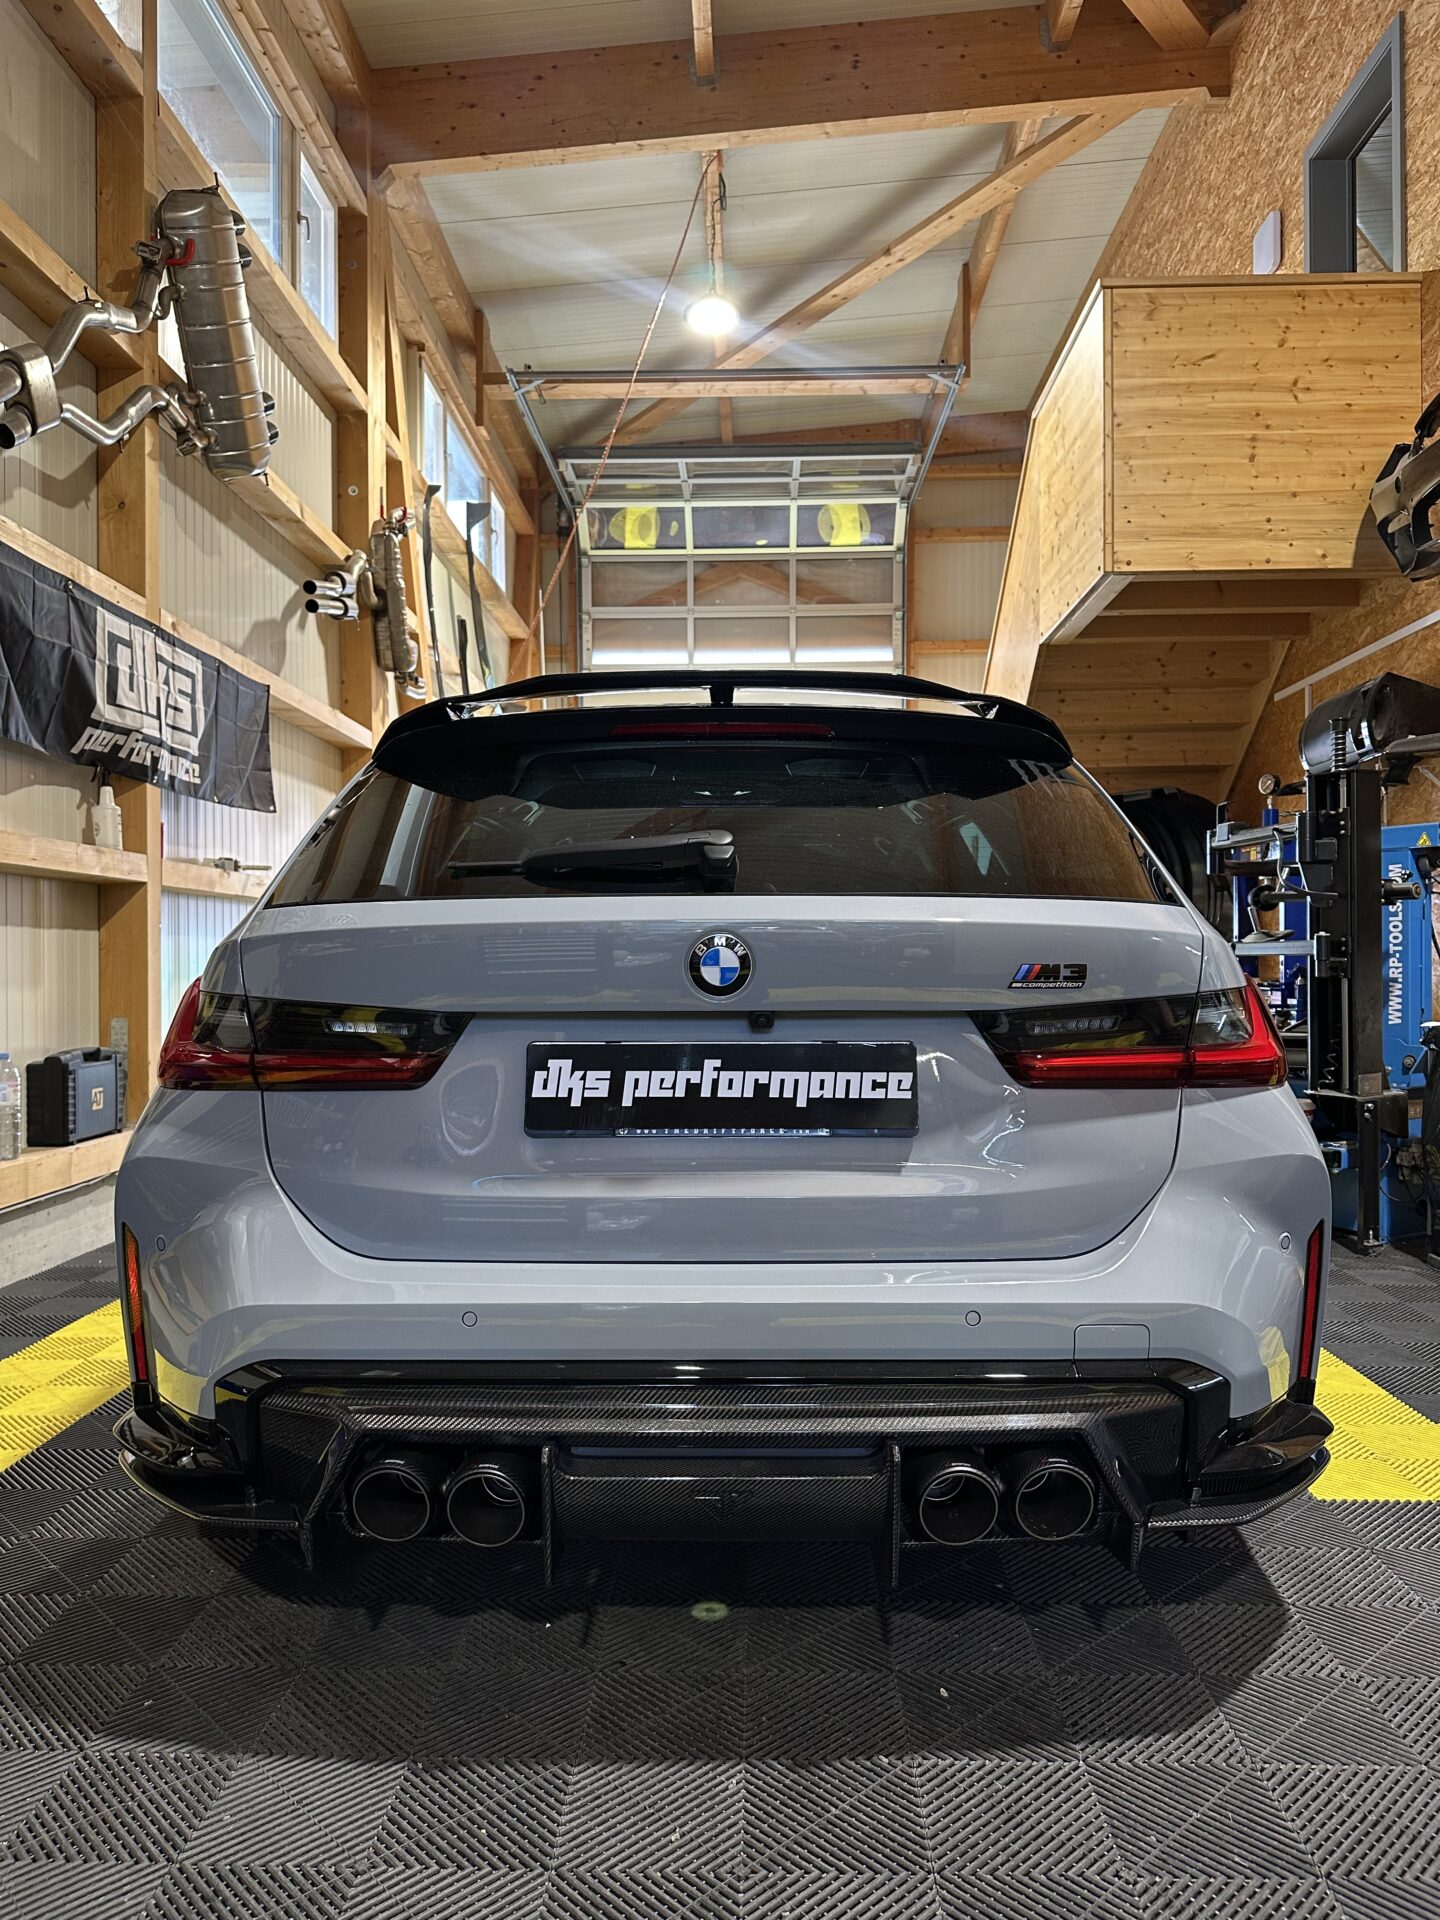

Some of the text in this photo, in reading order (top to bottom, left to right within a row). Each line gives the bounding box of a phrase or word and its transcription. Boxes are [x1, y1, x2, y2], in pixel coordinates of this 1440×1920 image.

[70, 726, 201, 784] performance
[694, 936, 747, 957] BMW
[1034, 963, 1088, 981] M3
[1022, 981, 1083, 989] competition
[621, 1058, 914, 1108] performance
